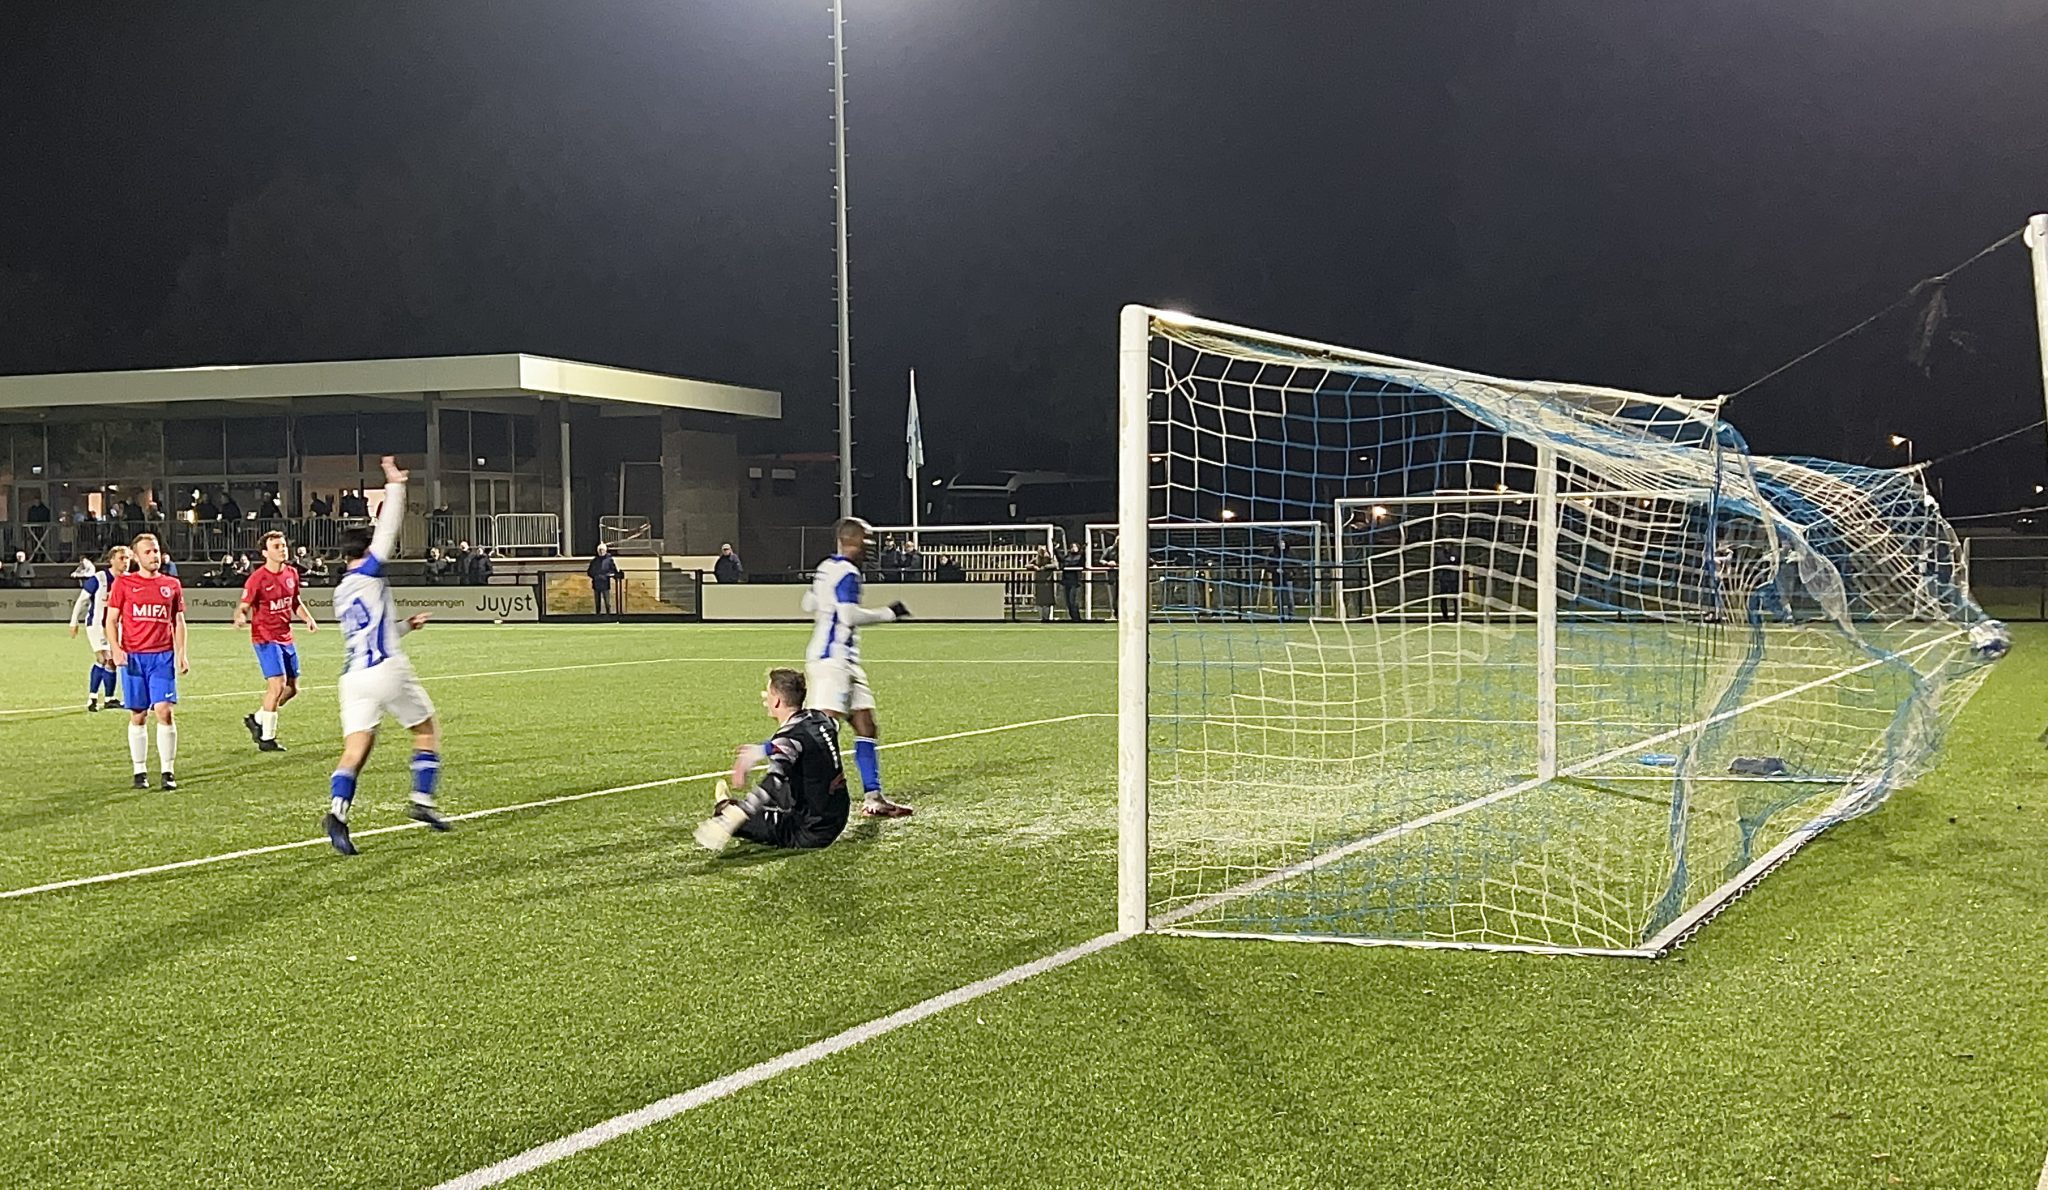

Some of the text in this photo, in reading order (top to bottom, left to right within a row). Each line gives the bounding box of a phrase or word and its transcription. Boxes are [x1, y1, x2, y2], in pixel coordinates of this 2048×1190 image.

[132, 603, 168, 618] MIFA
[191, 599, 237, 609] IT-Auditing
[475, 594, 533, 617] Juyst
